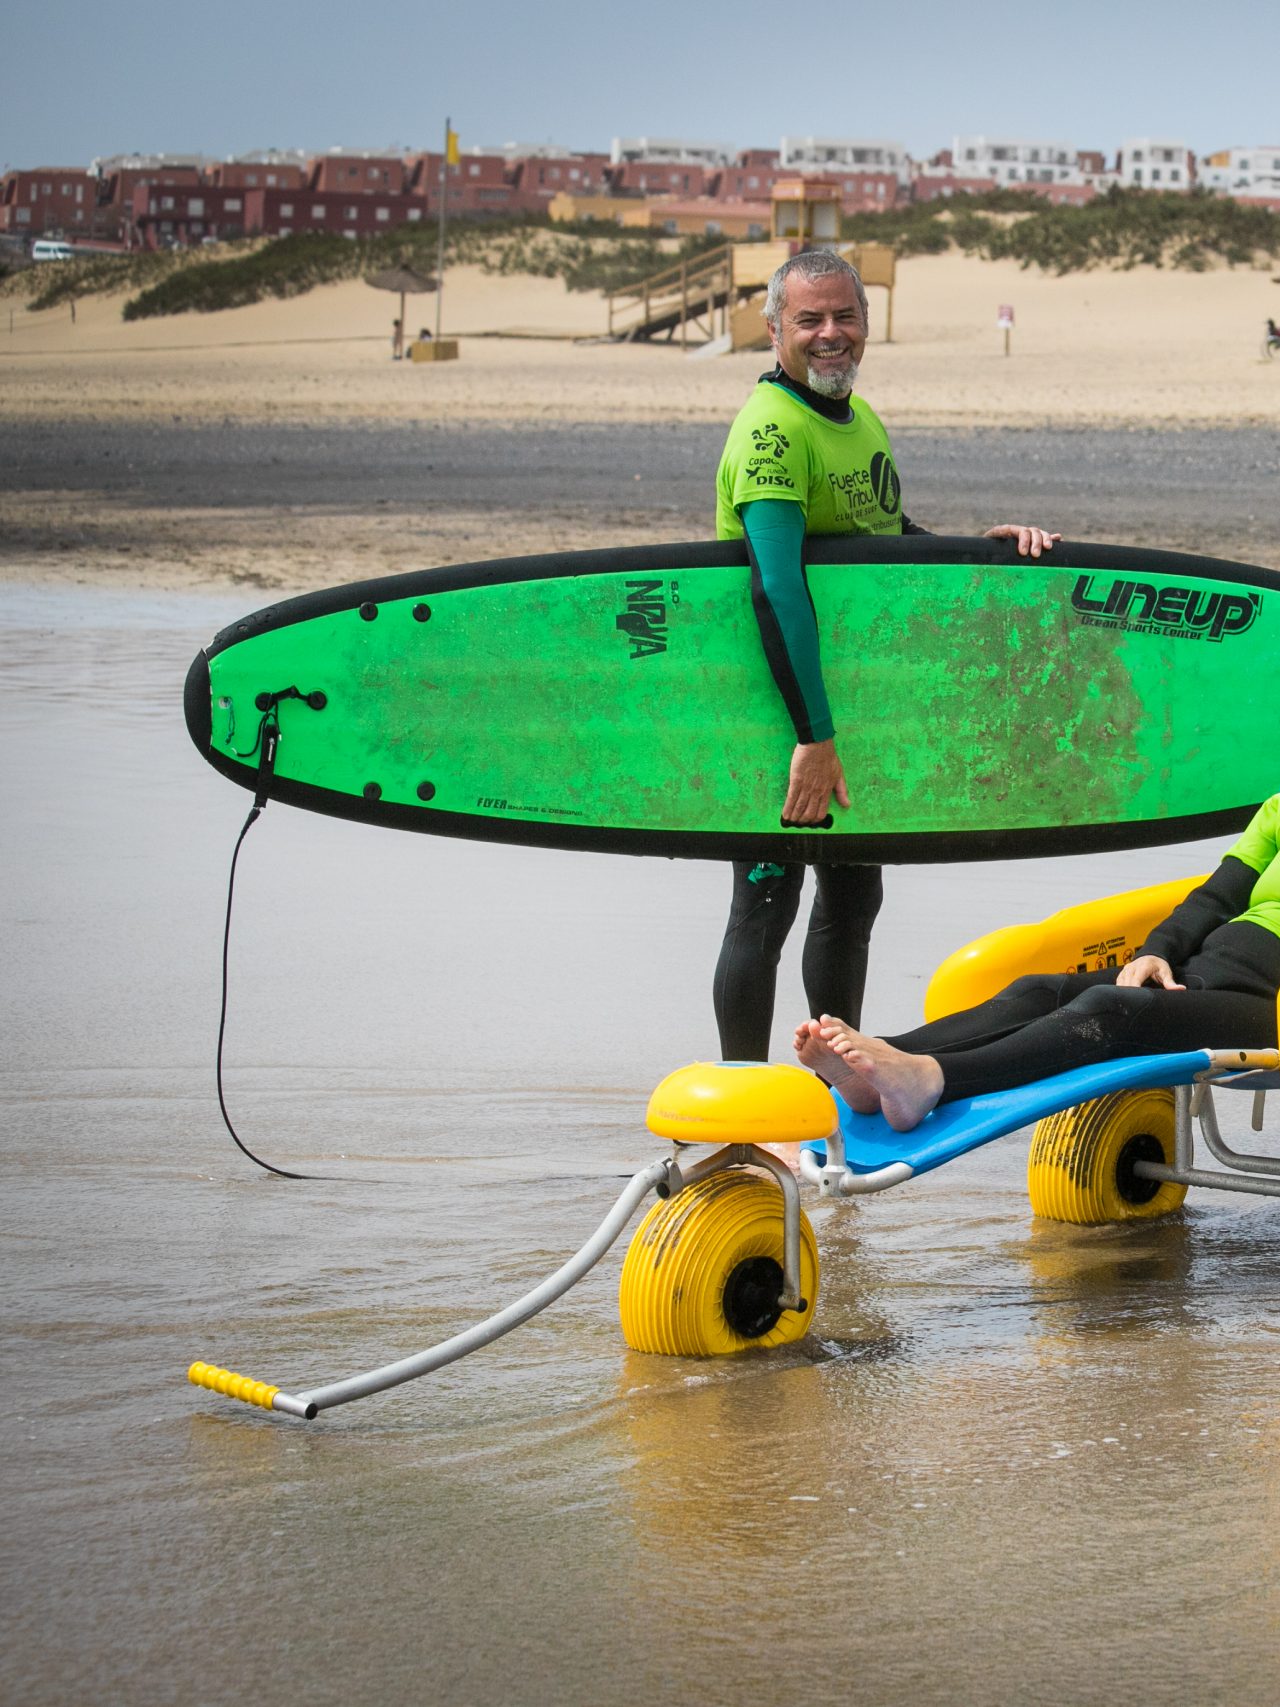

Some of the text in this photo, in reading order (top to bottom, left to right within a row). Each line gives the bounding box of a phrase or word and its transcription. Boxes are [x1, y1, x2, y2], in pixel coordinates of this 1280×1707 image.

[828, 468, 870, 492] Fuerte
[845, 487, 874, 509] Tribu
[1081, 615, 1204, 641] Ocean Sports Center
[476, 797, 508, 810] FLYER
